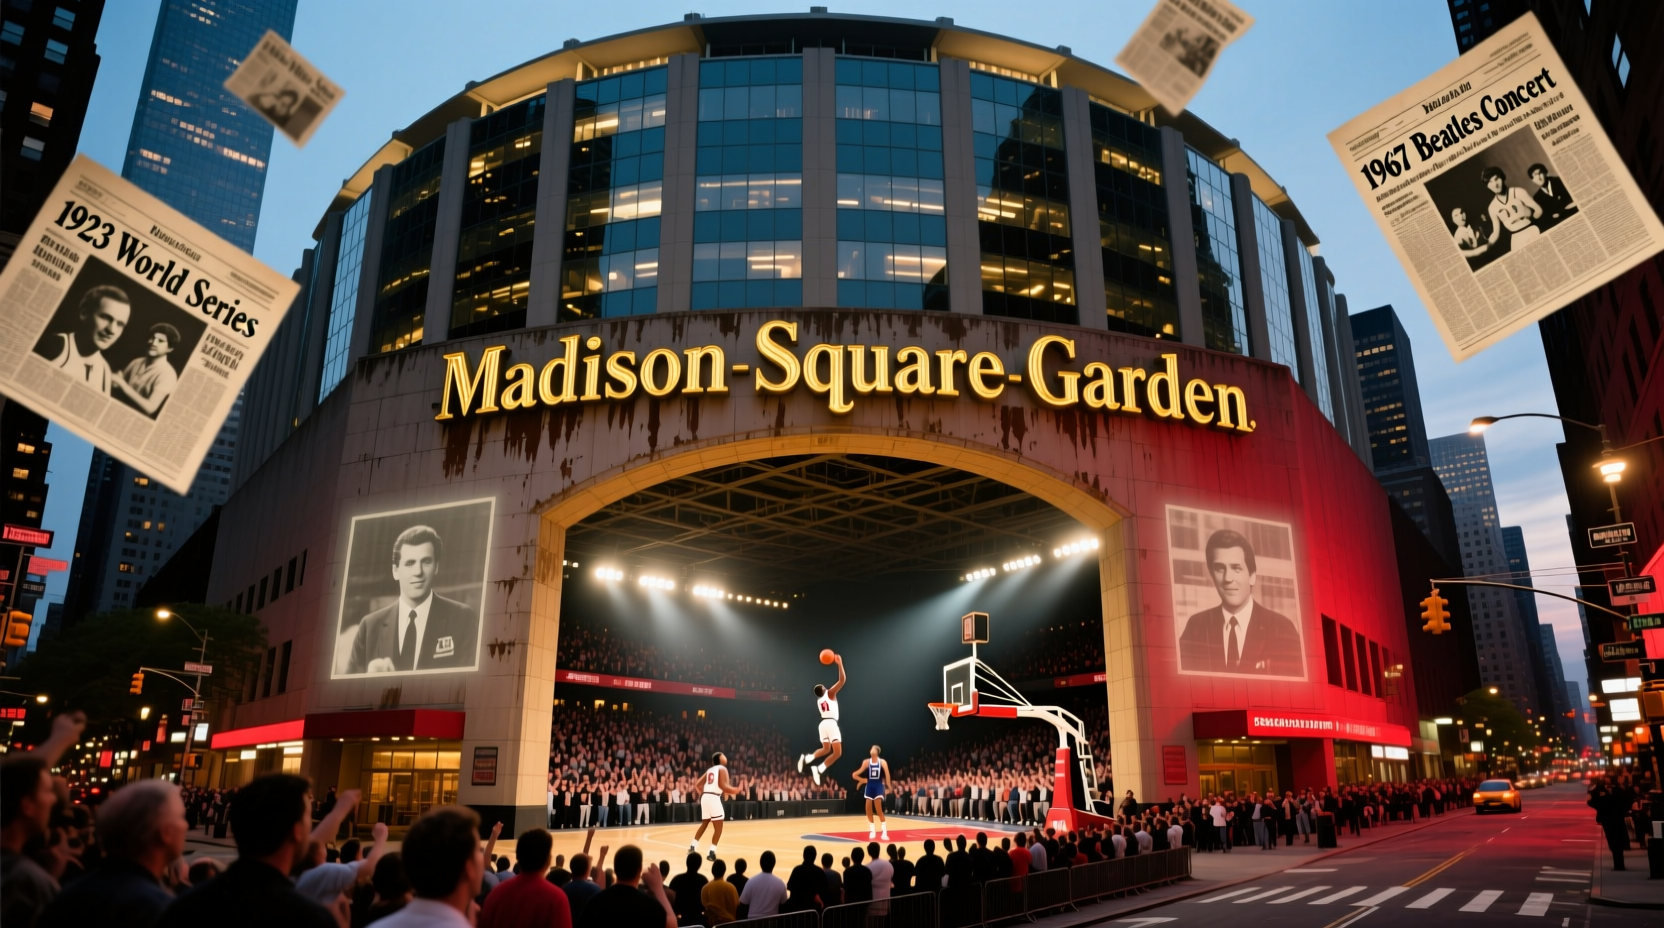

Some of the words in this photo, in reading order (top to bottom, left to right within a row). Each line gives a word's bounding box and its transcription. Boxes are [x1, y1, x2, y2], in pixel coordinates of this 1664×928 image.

[1360, 143, 1412, 190] 1967
[1409, 115, 1484, 161] Beatles
[1480, 67, 1557, 122] Concert
[54, 200, 115, 249] 1923
[116, 231, 190, 296] World
[185, 279, 259, 337] Series
